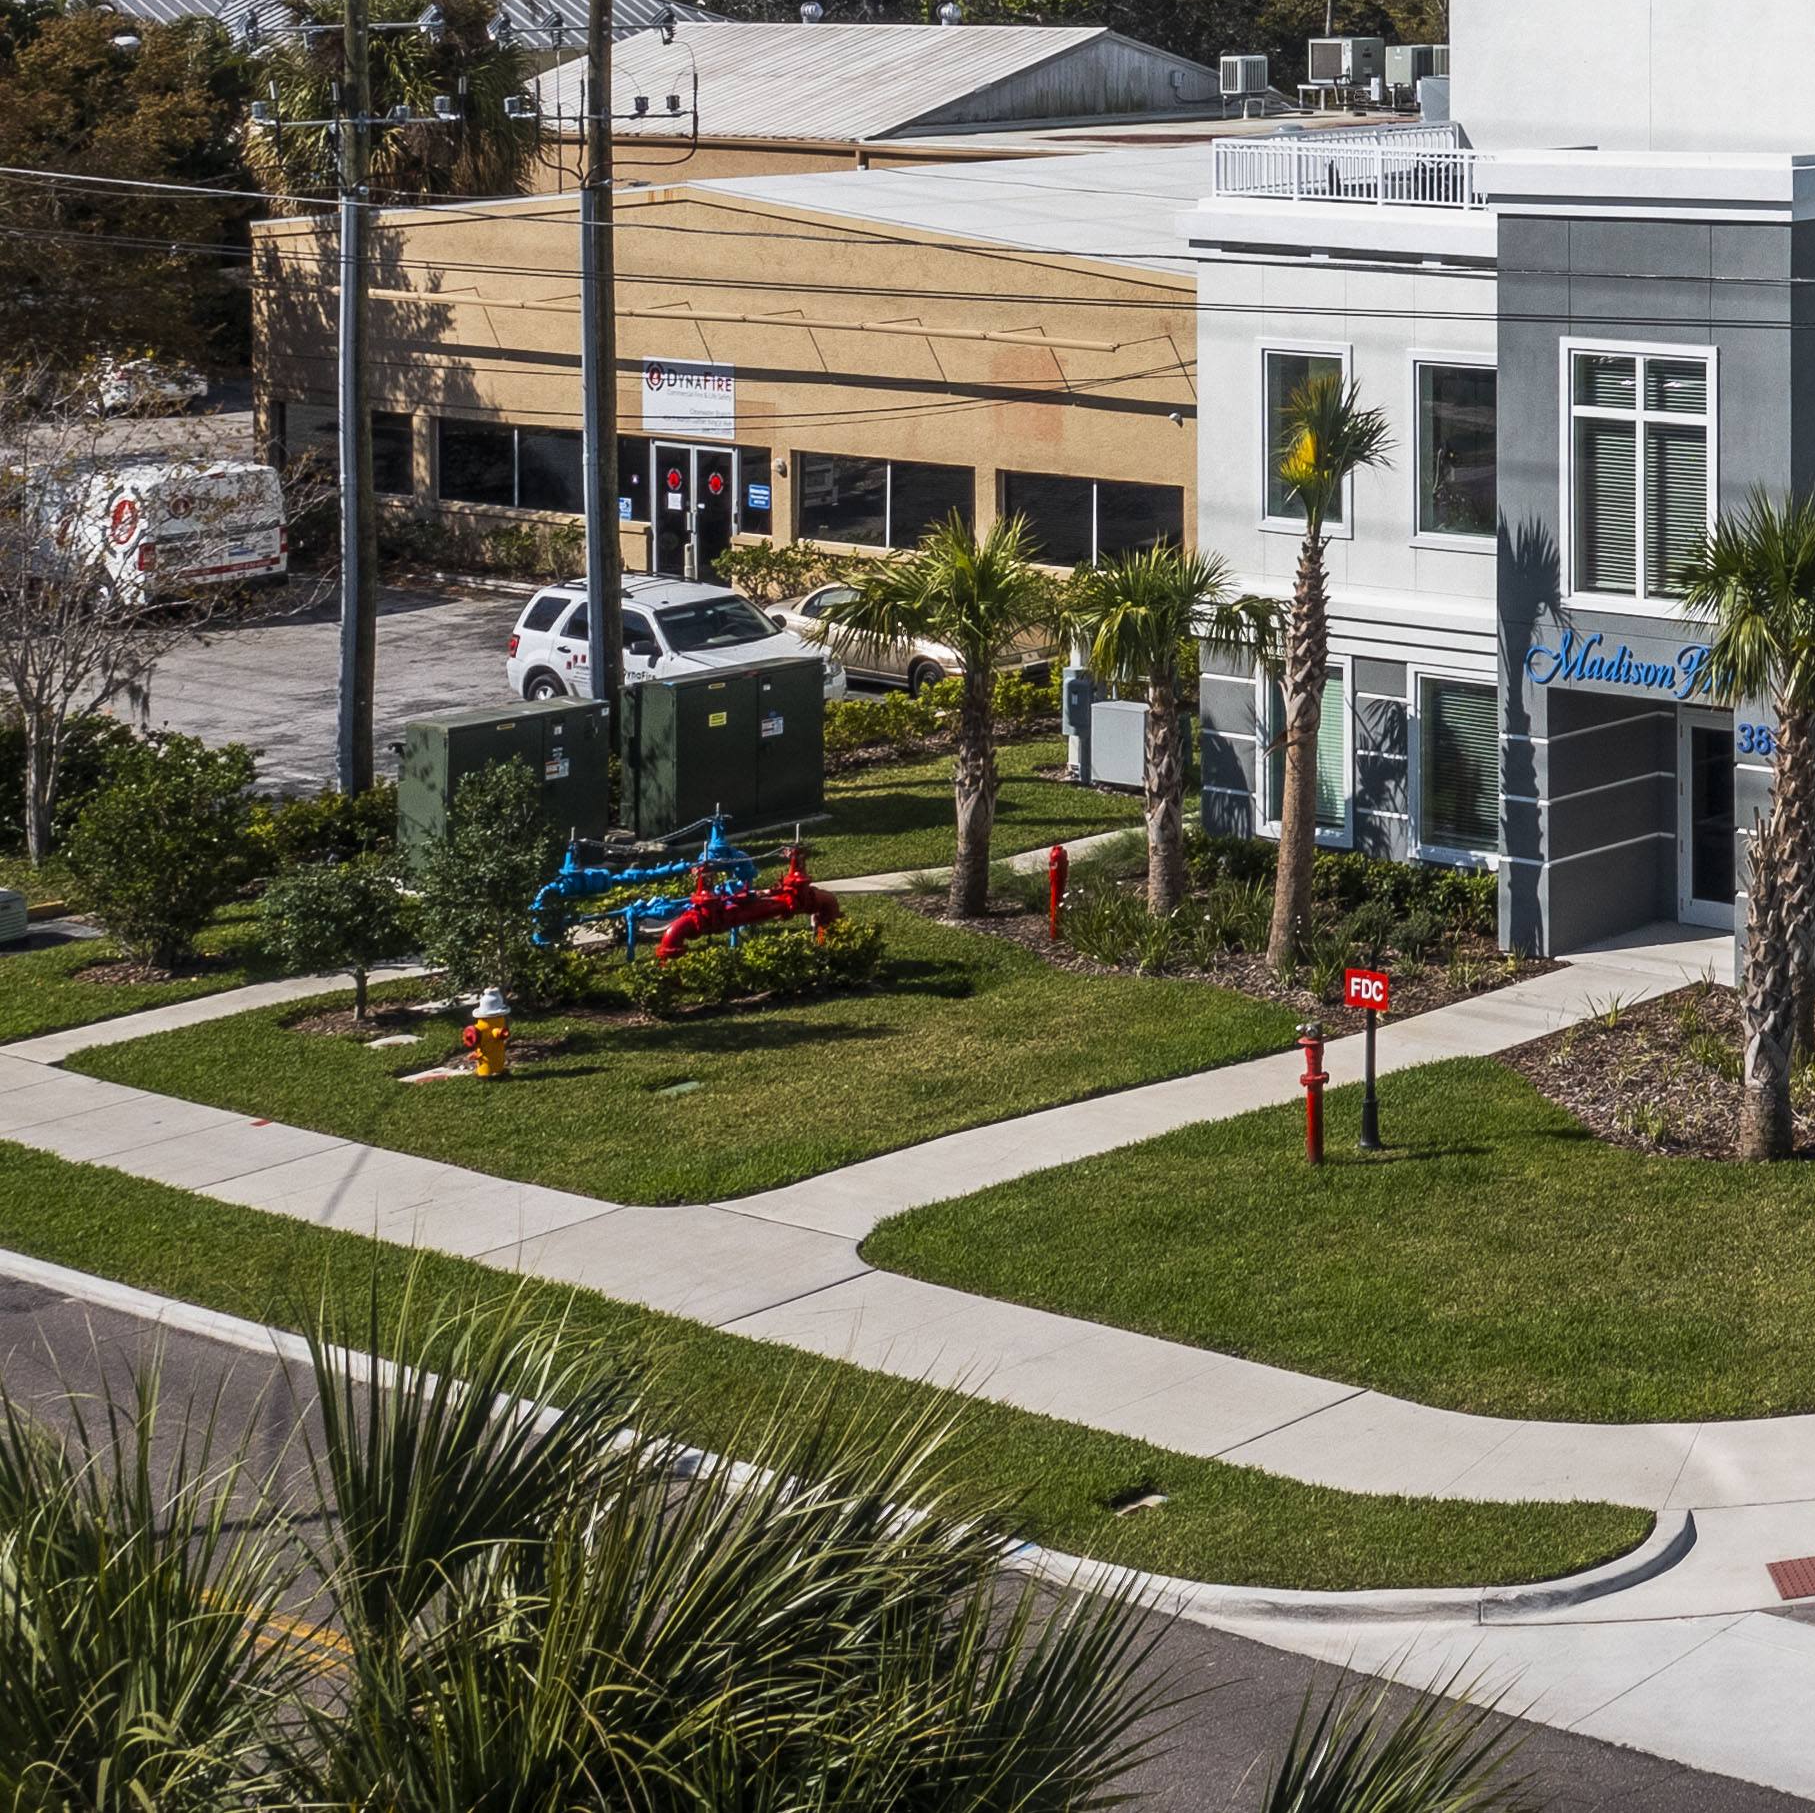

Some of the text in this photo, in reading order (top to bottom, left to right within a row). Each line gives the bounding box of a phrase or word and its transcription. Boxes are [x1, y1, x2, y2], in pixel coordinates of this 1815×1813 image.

[1524, 627, 1677, 690] Madison
[1737, 722, 1779, 756] 38
[1350, 977, 1384, 1002] FDC
